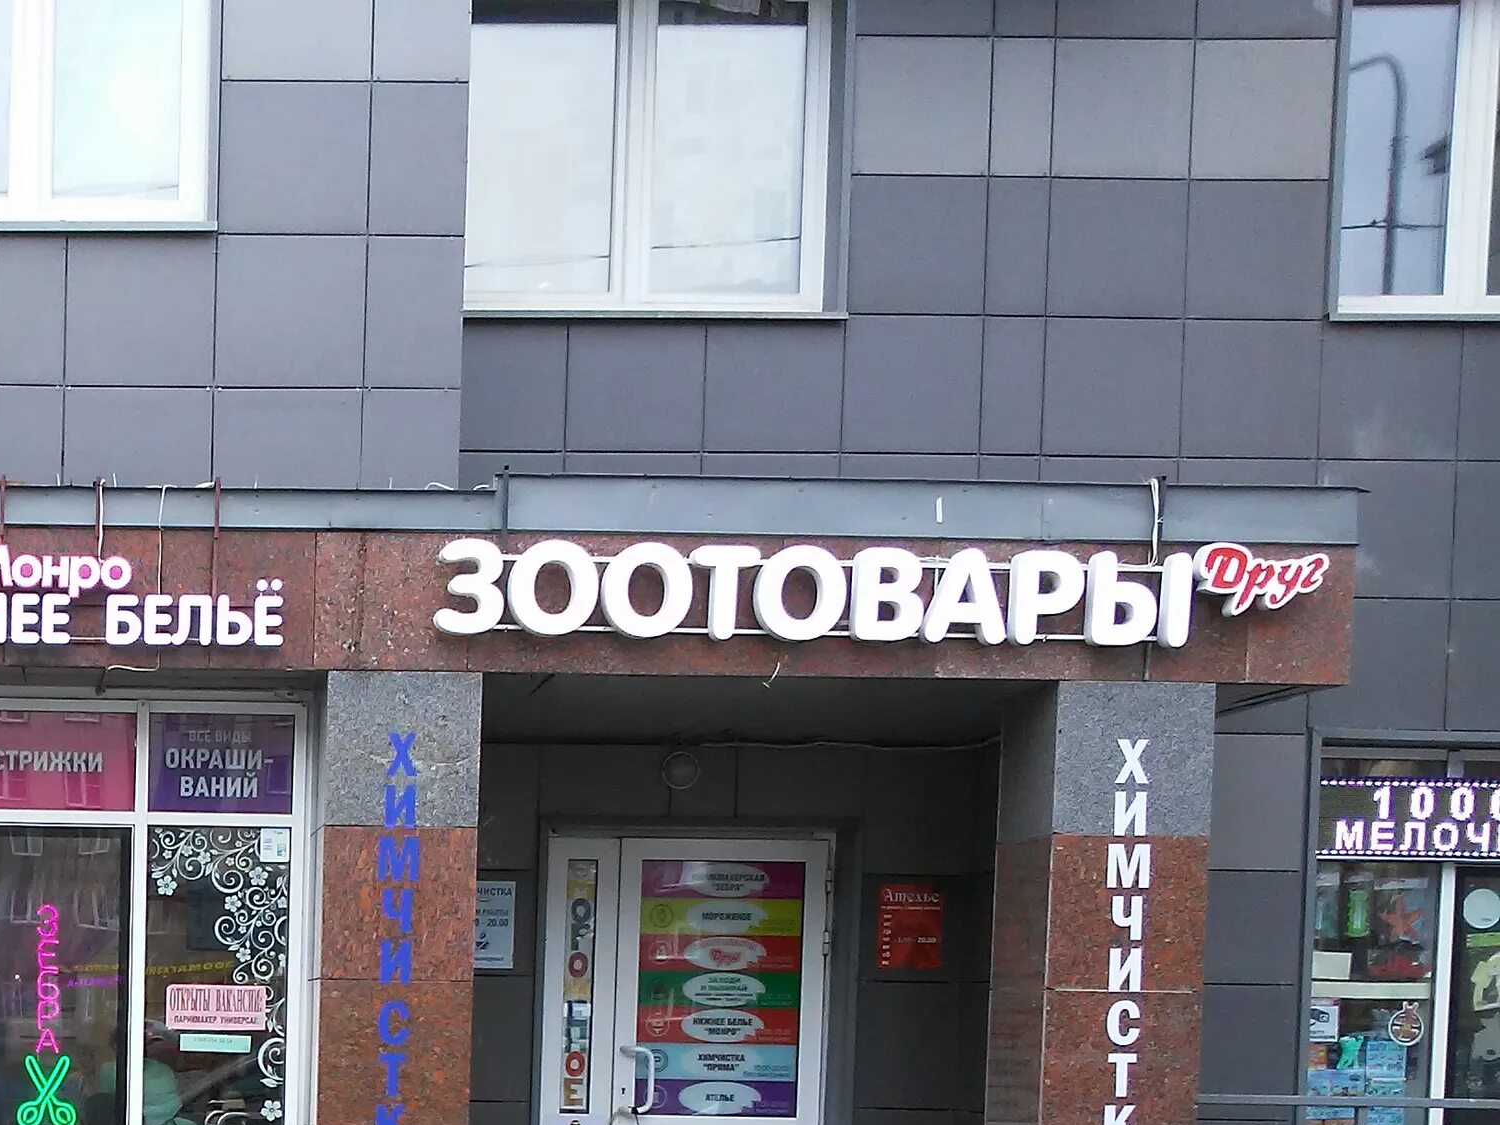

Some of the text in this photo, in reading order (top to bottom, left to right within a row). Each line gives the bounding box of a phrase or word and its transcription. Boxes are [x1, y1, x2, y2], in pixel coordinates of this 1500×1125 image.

[433, 538, 1192, 649] ЗООТОВАРЫ
[1198, 544, 1328, 614] Друг
[105, 578, 284, 647] БЕЛЬЁ
[165, 749, 273, 770] ОКРАШИ-
[180, 772, 258, 798] ВАНИЙ
[1335, 820, 1500, 851] МЕЛОЧ
[477, 887, 512, 896] ЧИСТКА
[36, 904, 60, 1053] ЗЕБРА
[170, 988, 211, 1011] ОТКРЫТЫ
